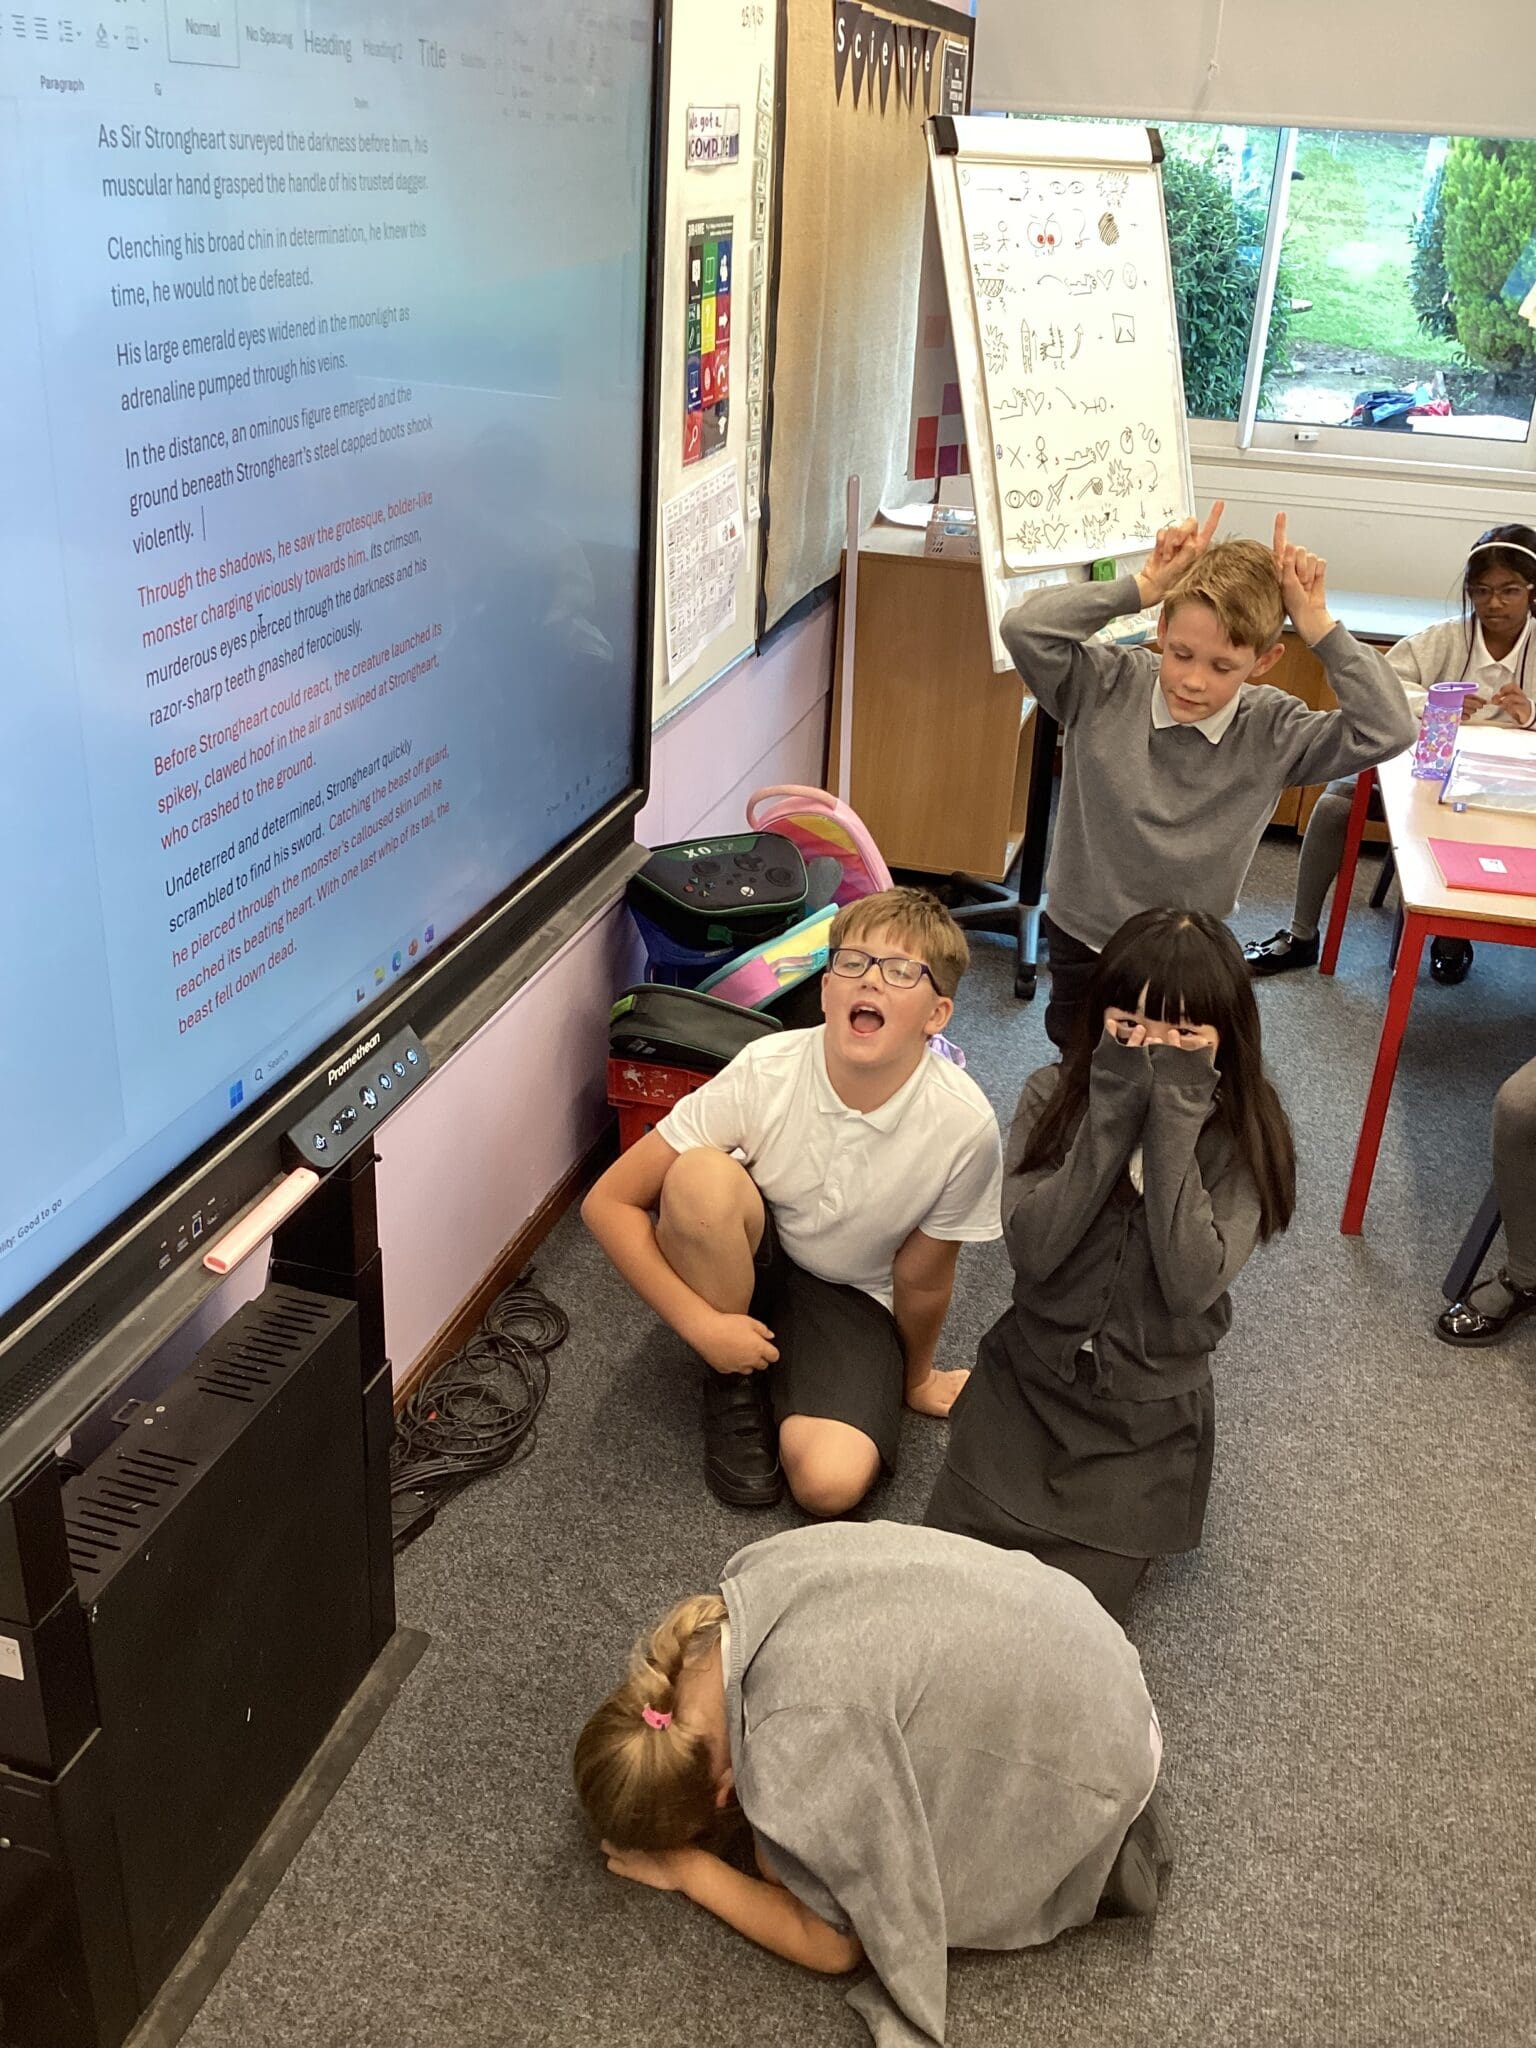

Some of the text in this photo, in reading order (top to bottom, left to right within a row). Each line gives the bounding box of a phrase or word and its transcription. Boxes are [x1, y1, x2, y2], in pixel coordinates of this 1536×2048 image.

[186, 18, 220, 38] Normal
[245, 25, 294, 49] No Spacing
[304, 29, 352, 63] Heading
[418, 38, 447, 69] Title
[837, 17, 930, 73] Science
[40, 75, 85, 93] Paragraph
[99, 124, 118, 148] As
[121, 125, 141, 148] Sir
[145, 125, 226, 155] Strongheart
[229, 130, 284, 155] surveyed
[286, 131, 305, 151] the
[308, 131, 356, 152] darkness
[103, 172, 394, 199] muscular hand grasped the handle of his trusted
[108, 234, 182, 260] Clenching
[185, 232, 205, 254] his
[208, 230, 245, 252] broad
[248, 229, 273, 250] chin
[276, 228, 287, 248] in
[111, 267, 313, 307] time, he would not be defeated.
[117, 306, 397, 366] His large emerald eyes widened in the moonlight
[122, 352, 347, 411] adrenaline pumped through his veins.
[126, 393, 375, 469] In the distance, an ominous figure emerged
[130, 480, 178, 517] ground
[182, 467, 233, 497] beneath
[314, 438, 339, 461] steel
[341, 428, 377, 454] capped
[380, 424, 405, 443] boots
[133, 520, 193, 554] violently.
[137, 572, 193, 607] Through
[196, 567, 216, 587] the
[220, 548, 275, 579] shadows,
[278, 541, 291, 558] he
[294, 533, 315, 552] saw
[318, 526, 333, 544] the
[336, 510, 385, 542] grotesque,
[143, 530, 421, 648] monster charging viciously towards him. Its crimson,
[146, 559, 427, 688] murderous eyes pierced through the darkness and his
[150, 620, 362, 727] razor-sharp teeth gnashed ferociously.
[154, 626, 430, 776] Before Strongheart could react, the creature launched
[158, 681, 387, 814] spikey, clawed hoof in the air and swiped at
[161, 752, 316, 850] who crashed to the ground.
[166, 740, 412, 896] Undeterred and determined, Strongheart quickly
[170, 769, 411, 932] scrambled to find his sword. Catching the beast
[173, 948, 188, 967] he
[192, 912, 235, 959] pierced
[238, 885, 280, 923] through
[282, 875, 299, 894] the
[351, 808, 393, 848] calloused
[176, 851, 376, 1001] reached its beating heart. With one last
[179, 939, 297, 1034] beast fell down dead.
[328, 1033, 380, 1086] Promethean
[17, 1197, 63, 1238] Good to go
